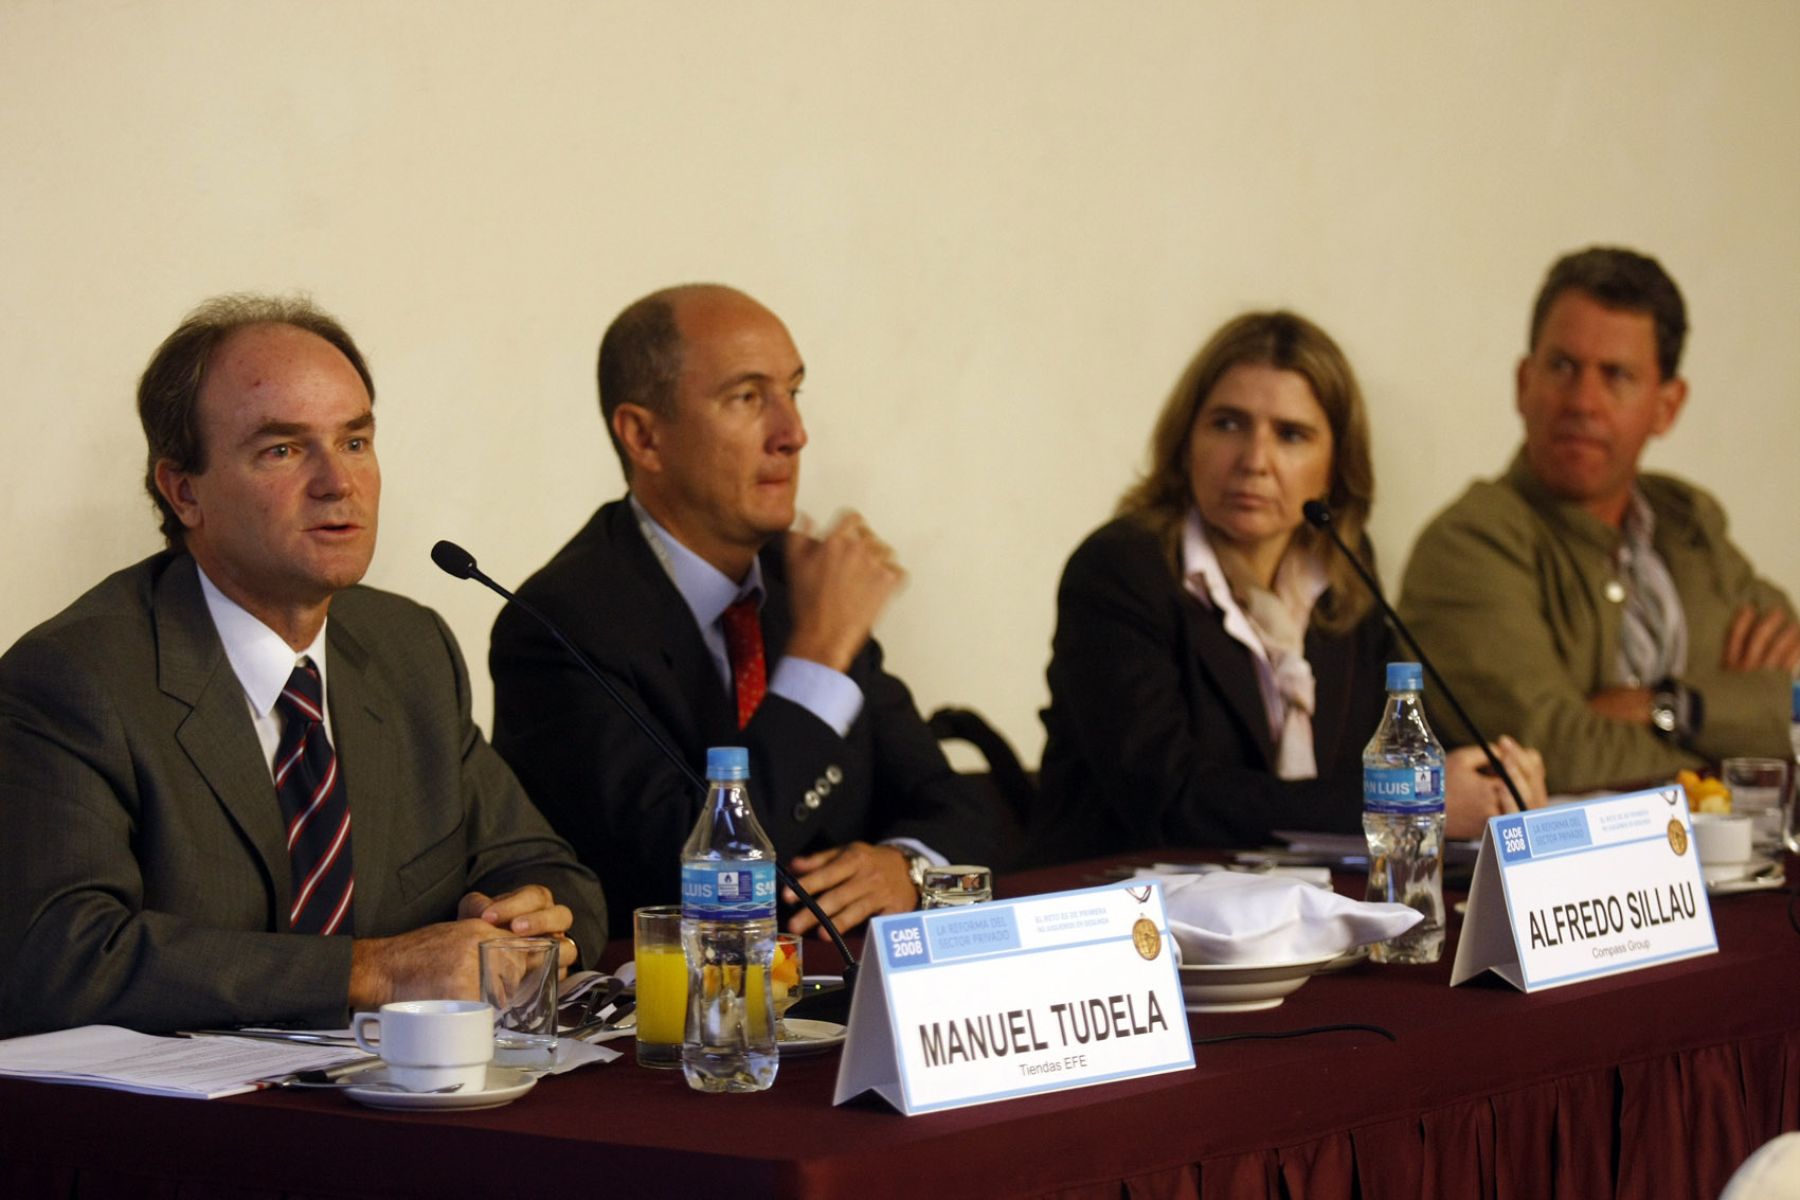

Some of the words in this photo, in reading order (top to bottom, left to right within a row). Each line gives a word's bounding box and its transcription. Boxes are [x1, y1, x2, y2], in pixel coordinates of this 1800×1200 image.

[1378, 782, 1410, 795] LUIS
[1503, 826, 1524, 840] CADE
[1505, 838, 1526, 853] 2008
[684, 883, 712, 898] LUIS
[1529, 895, 1624, 949] ALFREDO
[1627, 881, 1696, 930] SILLAU
[890, 927, 921, 942] CADE
[936, 925, 946, 937] LA
[948, 919, 989, 934] REFORMA
[990, 916, 1008, 929] DEL
[938, 934, 972, 949] SECTOR
[972, 929, 1010, 943] PRIVADO
[893, 940, 923, 958] 2008
[1592, 943, 1628, 960] Compass
[1628, 938, 1651, 954] Group
[919, 1008, 1049, 1068] MANUEL
[1050, 990, 1168, 1046] TUDELA
[1019, 1059, 1062, 1077] Tiendas
[1064, 1054, 1088, 1070] EFE
